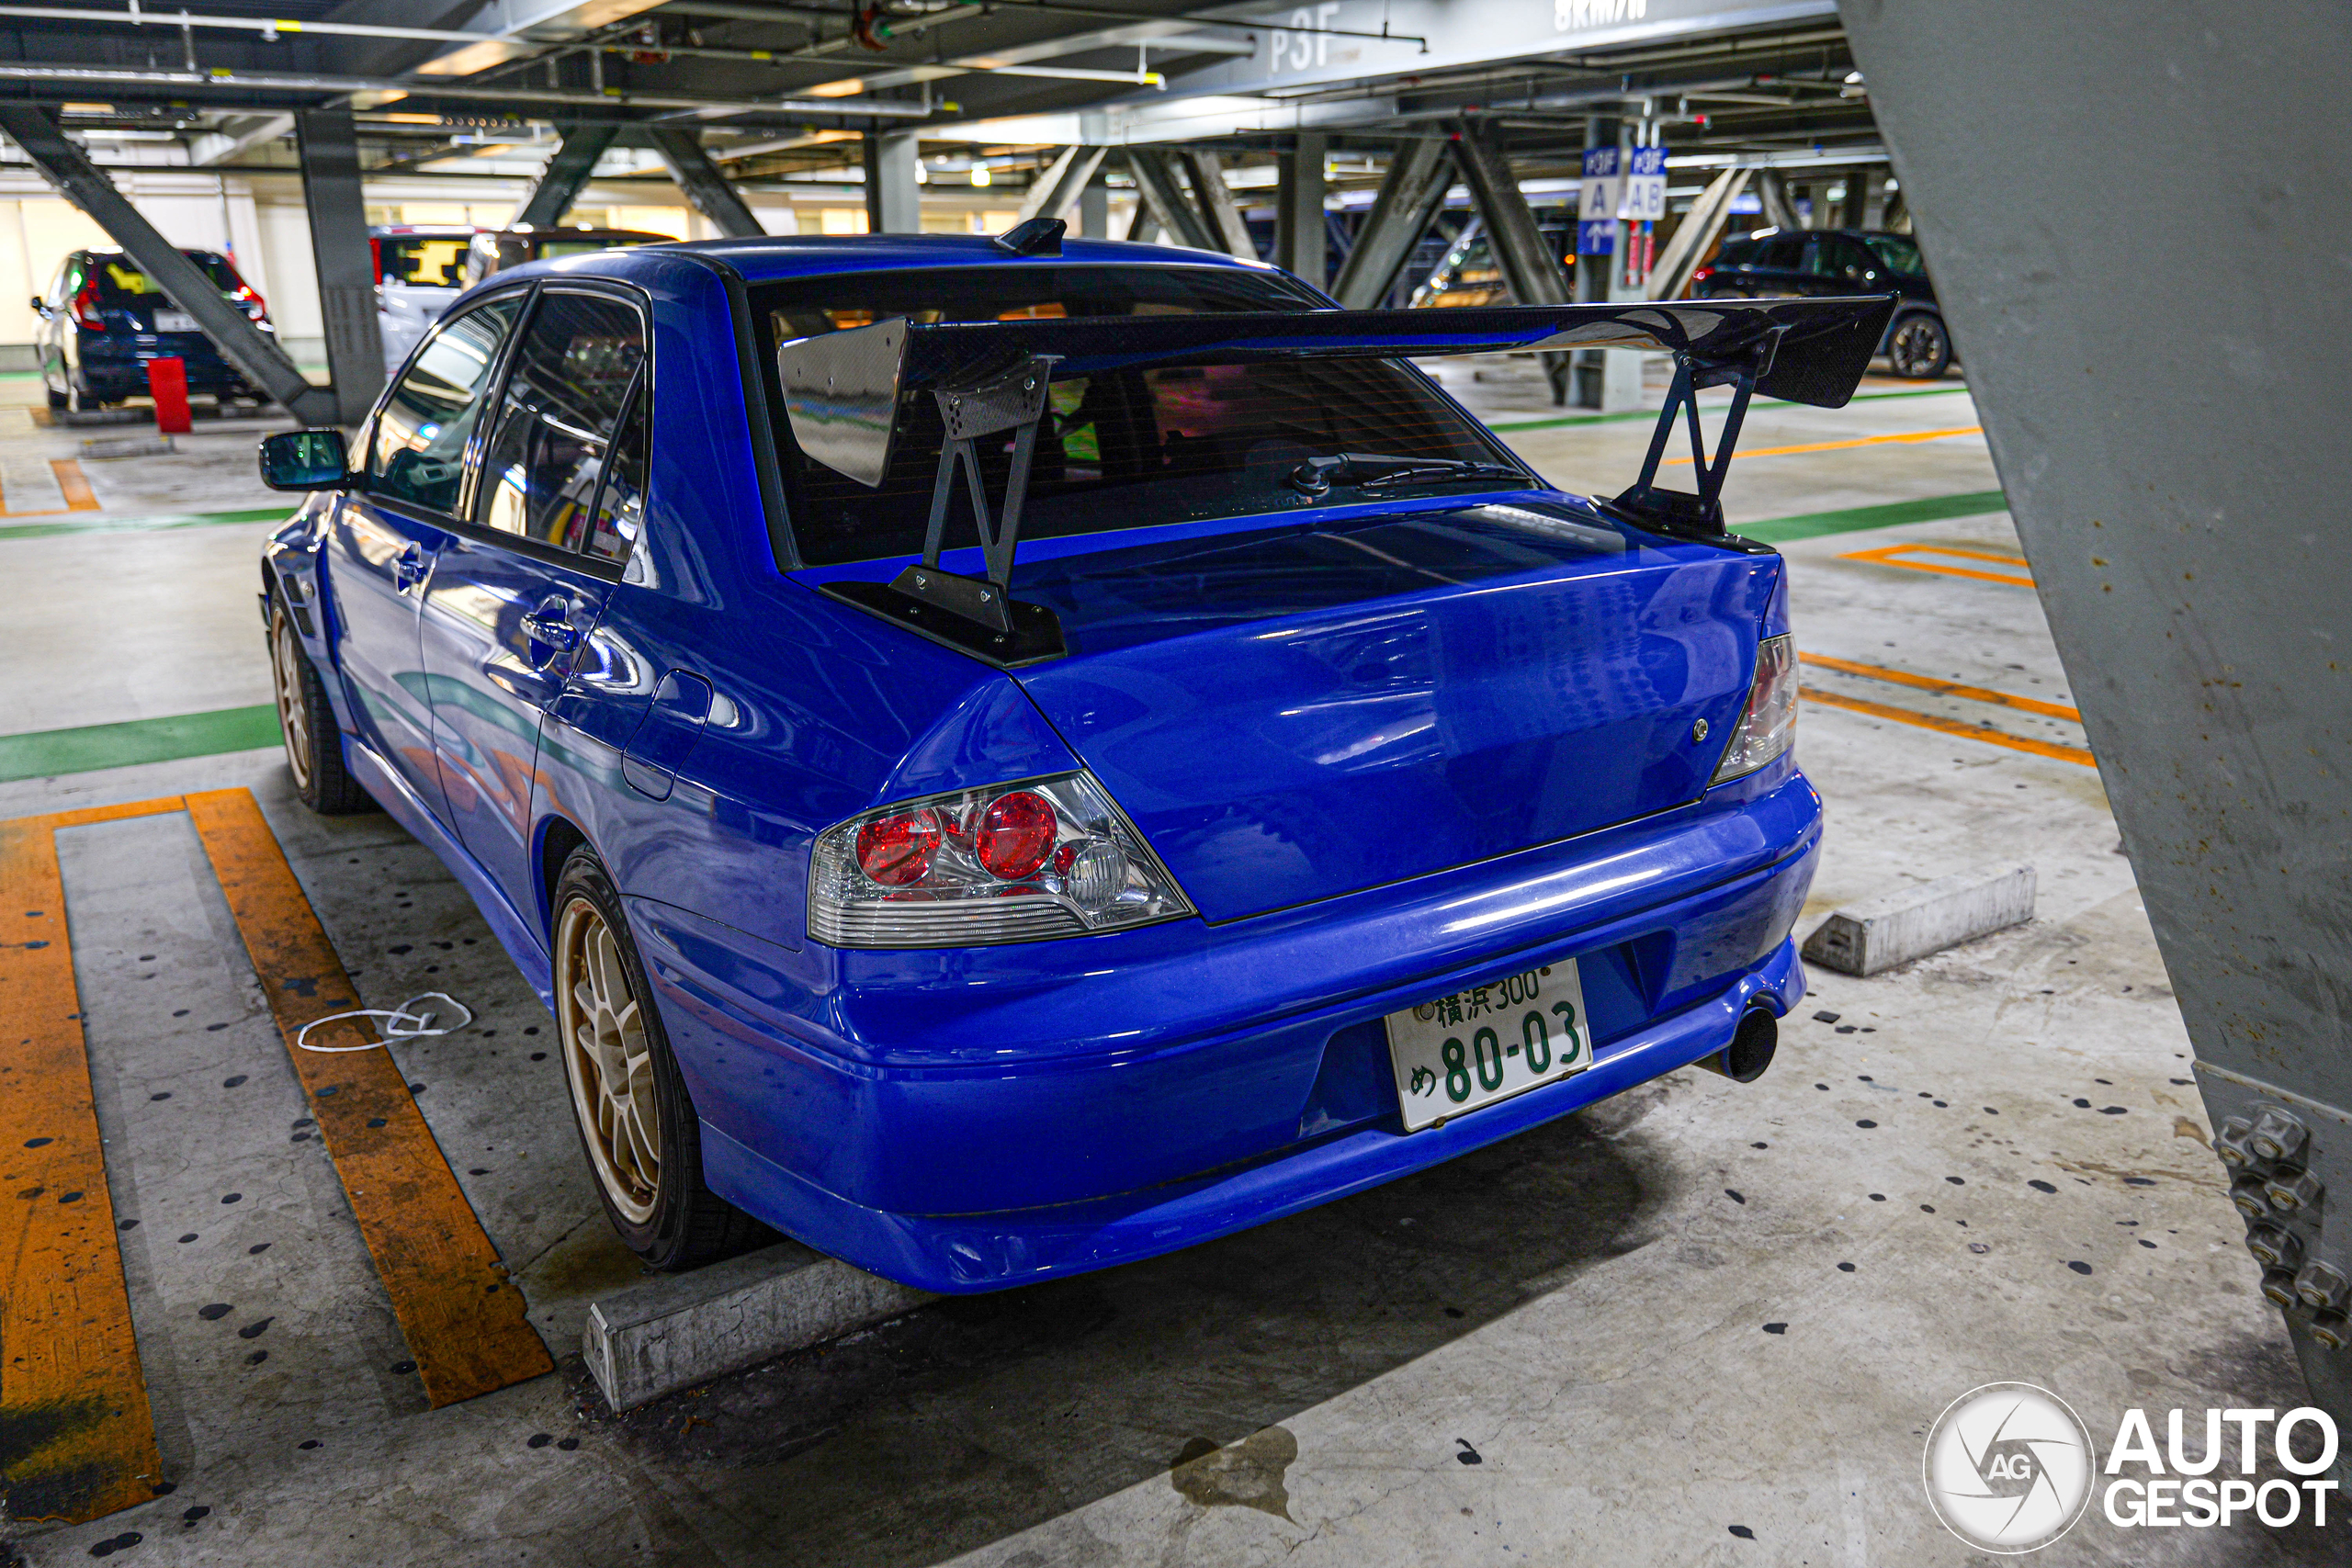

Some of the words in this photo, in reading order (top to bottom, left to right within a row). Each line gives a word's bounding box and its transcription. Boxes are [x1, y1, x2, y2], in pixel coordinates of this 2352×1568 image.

[1271, 3, 1340, 73] P3F
[1589, 184, 1607, 215] A
[1442, 1000, 1580, 1103] 80-03
